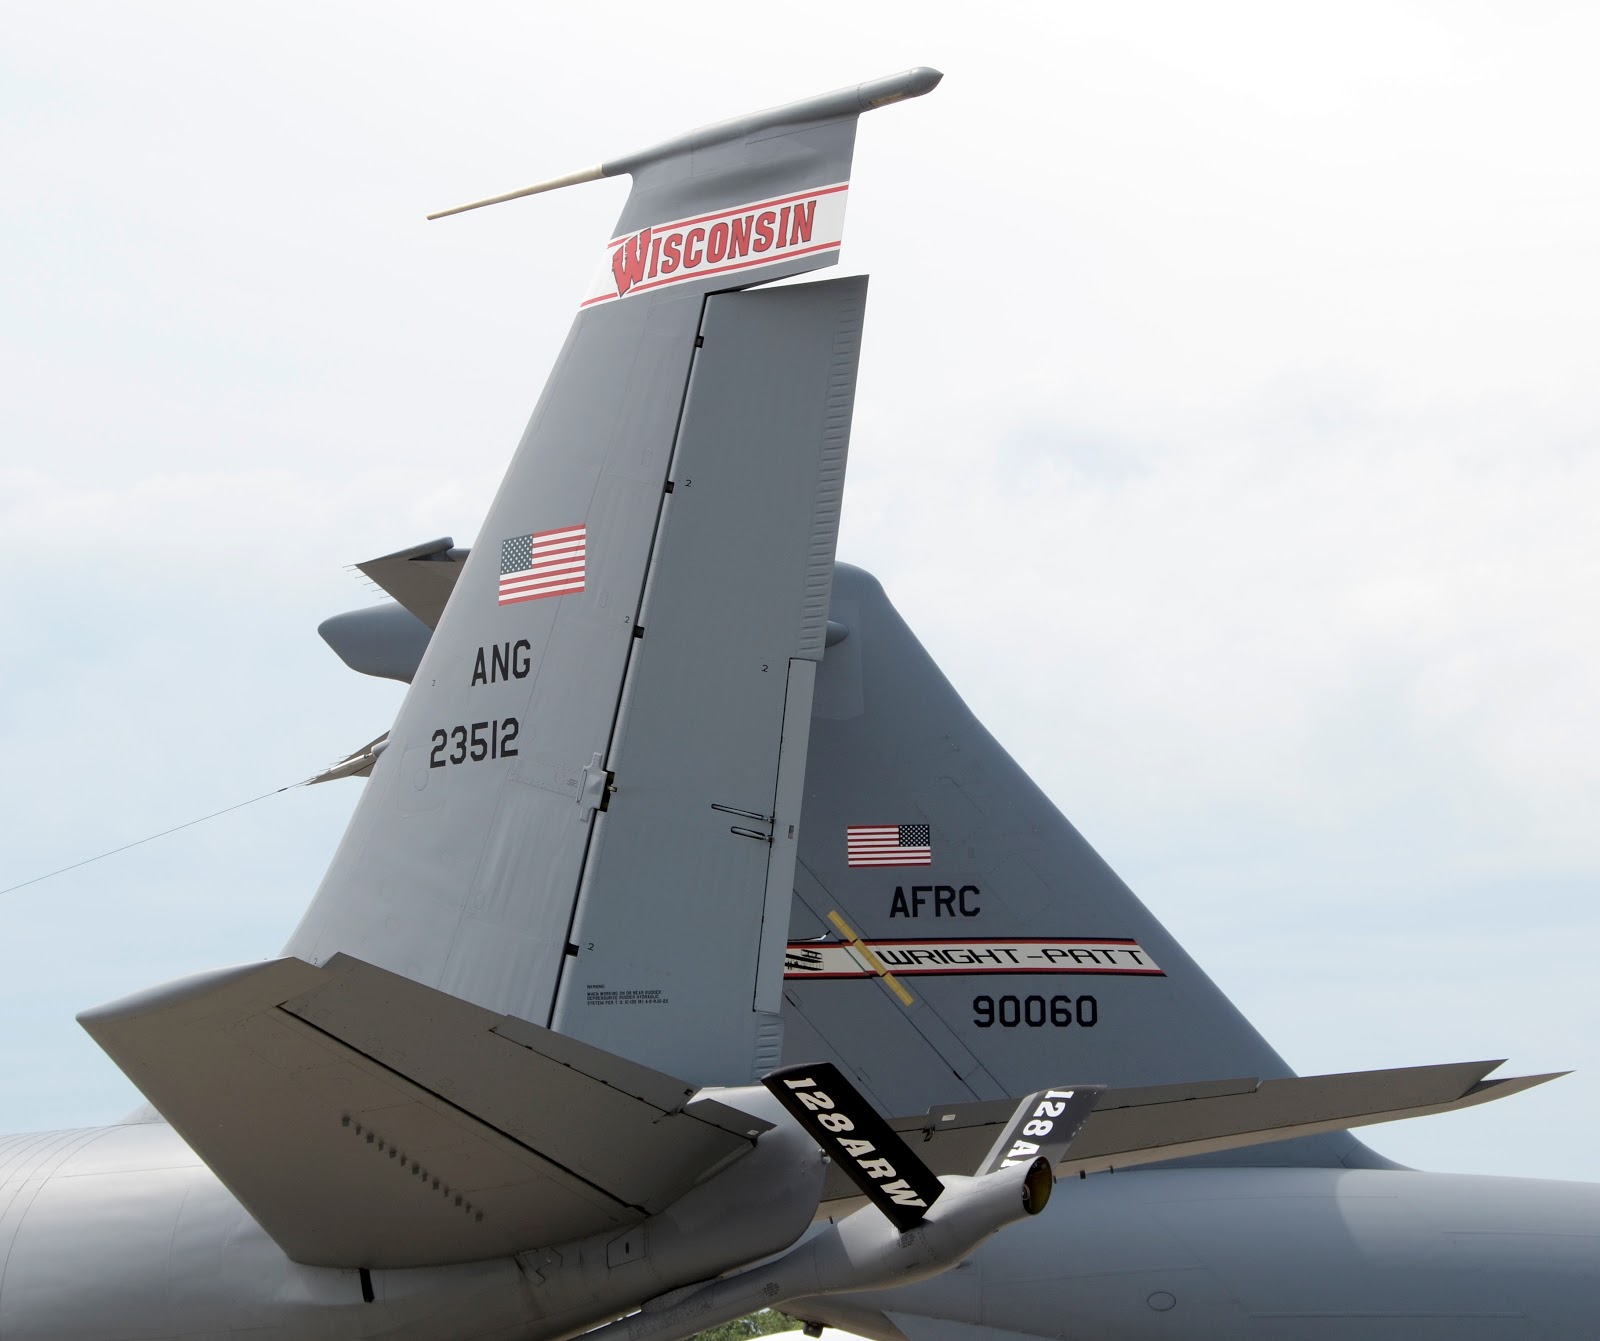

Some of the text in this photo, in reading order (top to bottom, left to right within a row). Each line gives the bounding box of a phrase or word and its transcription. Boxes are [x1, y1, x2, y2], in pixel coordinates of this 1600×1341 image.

[612, 200, 817, 298] WISCONSIN
[684, 479, 692, 488] 2
[471, 639, 531, 686] ANG
[761, 664, 769, 673] 2
[430, 717, 519, 768] 23512
[889, 885, 981, 918] AFRC
[587, 942, 595, 951] 2
[973, 995, 1098, 1028] 90060
